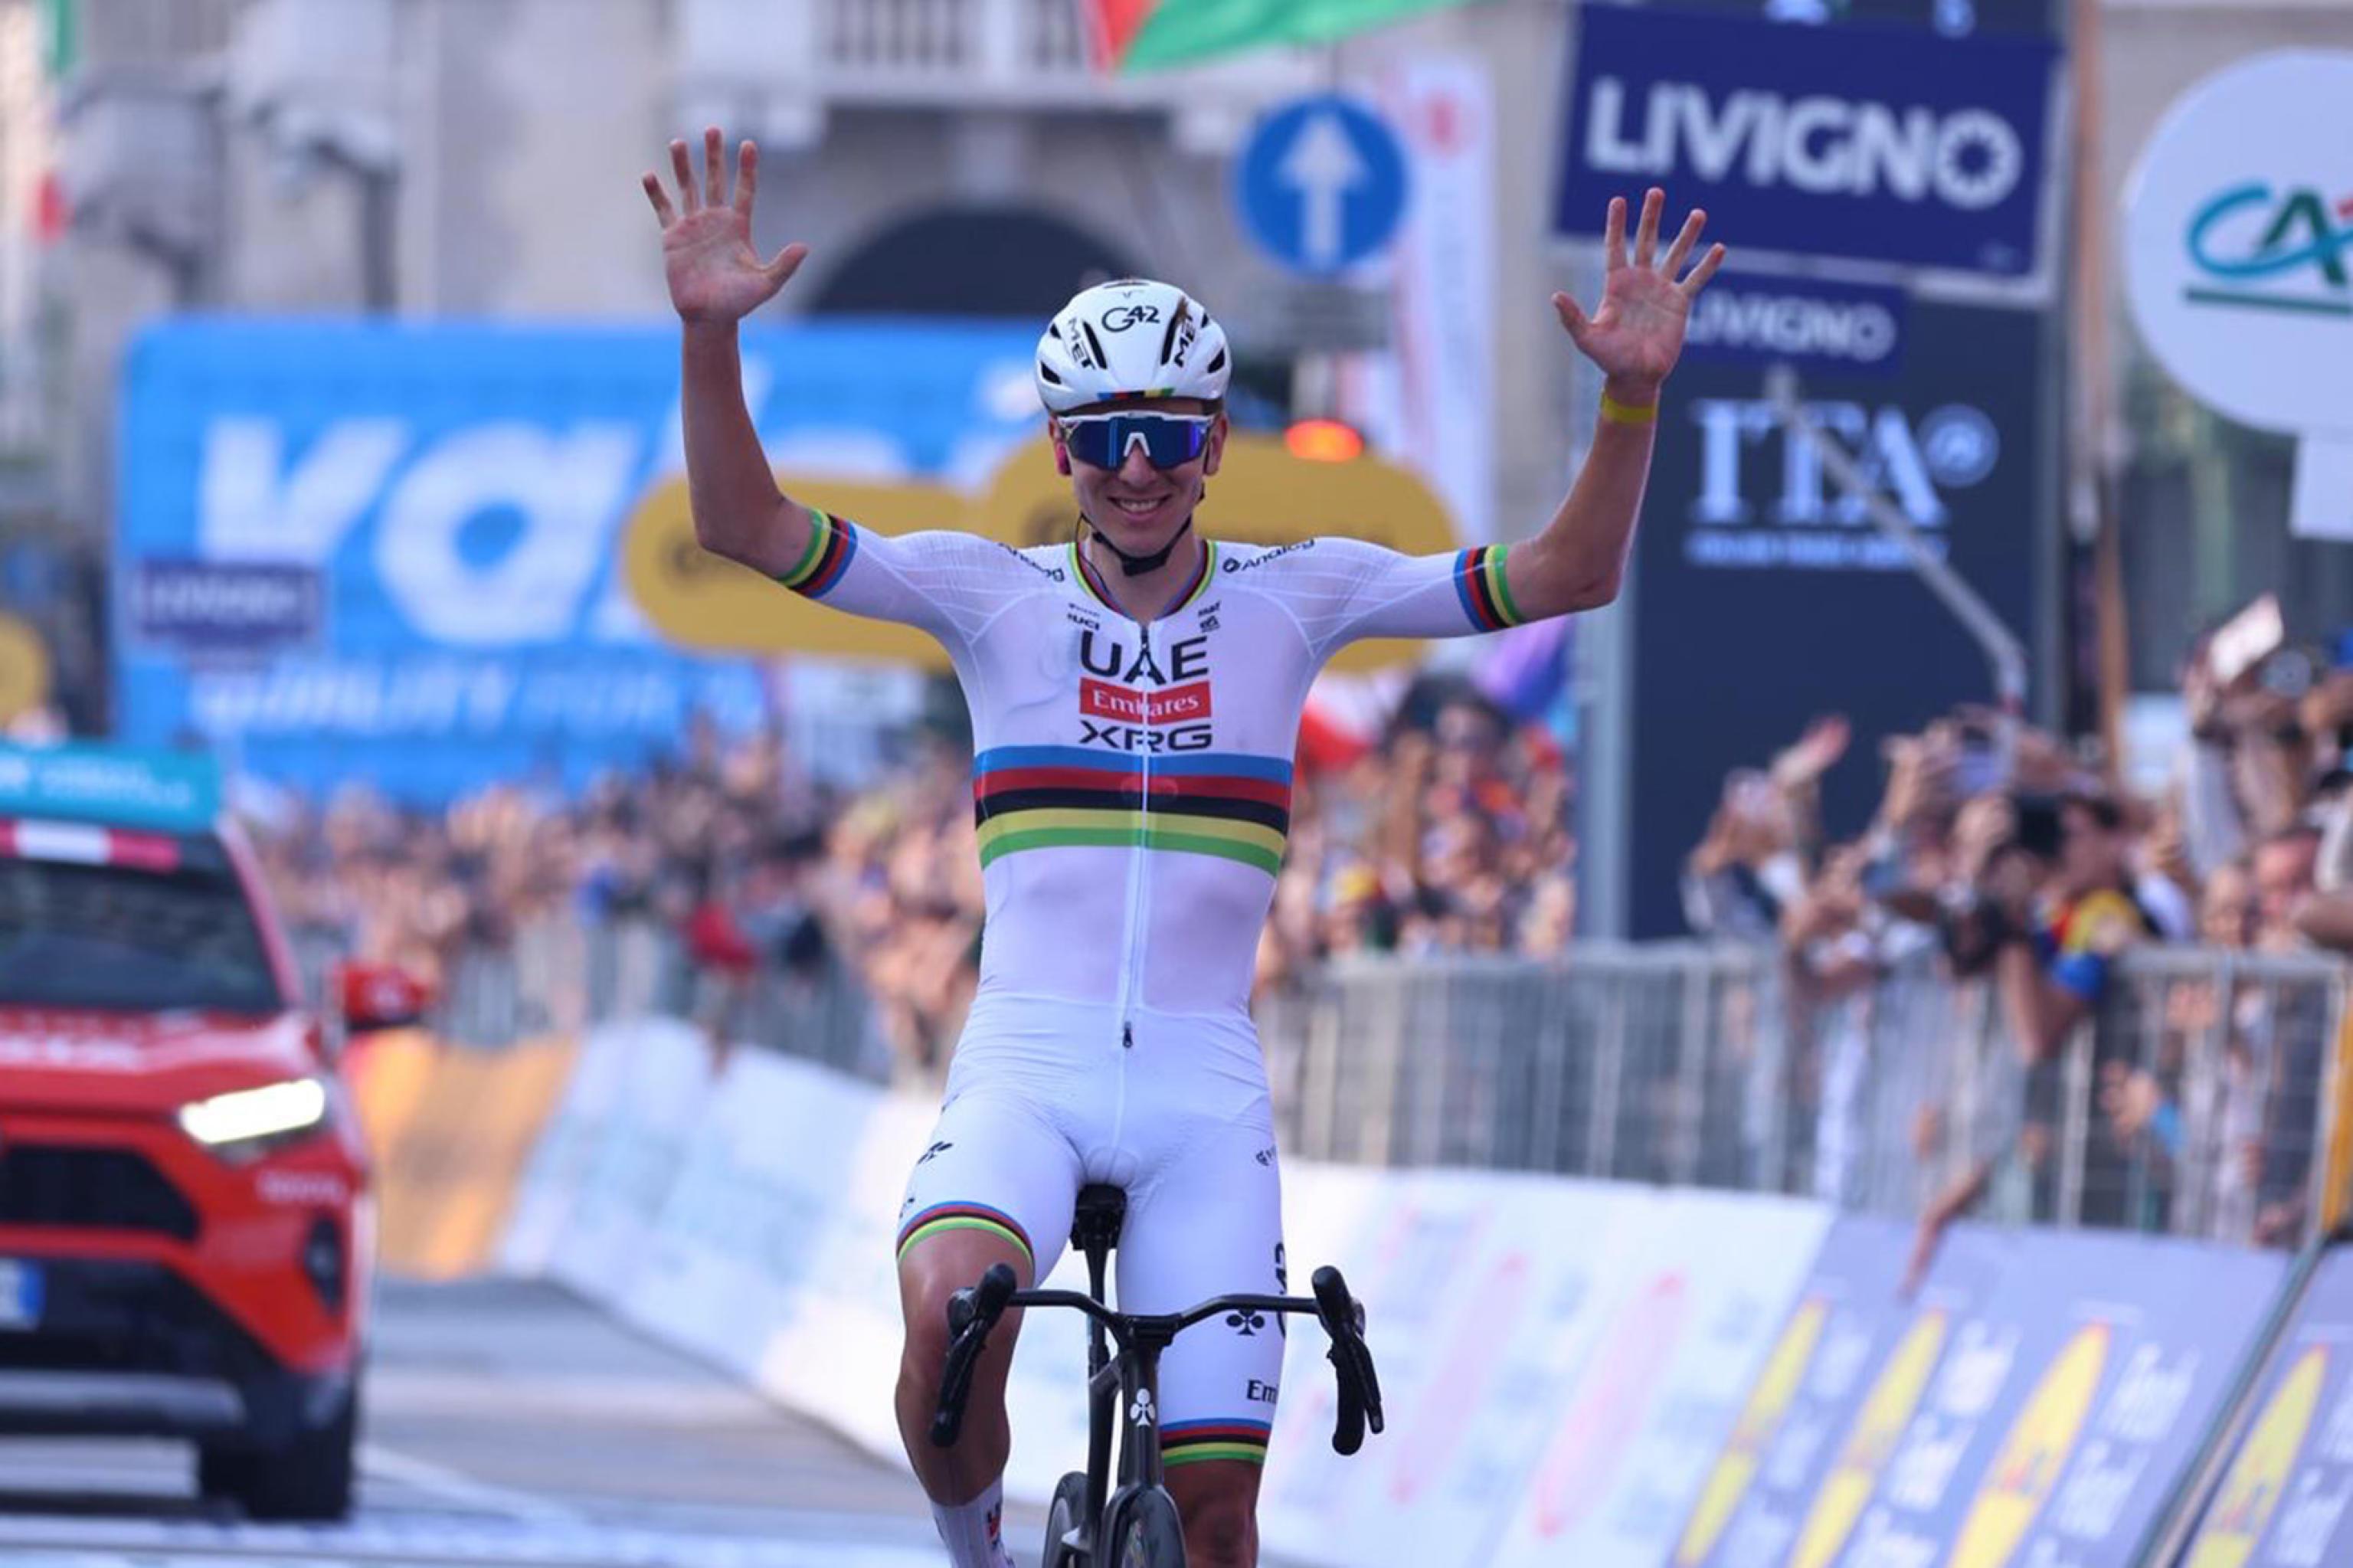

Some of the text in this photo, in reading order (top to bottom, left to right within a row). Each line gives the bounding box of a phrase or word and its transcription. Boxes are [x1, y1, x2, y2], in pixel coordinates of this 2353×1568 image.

[1587, 77, 2023, 209] LIVIGNO
[1101, 305, 1160, 332] G42
[1686, 288, 1896, 363] IVIGNO
[1081, 630, 1208, 685] UAE
[1079, 719, 1211, 752] XRG
